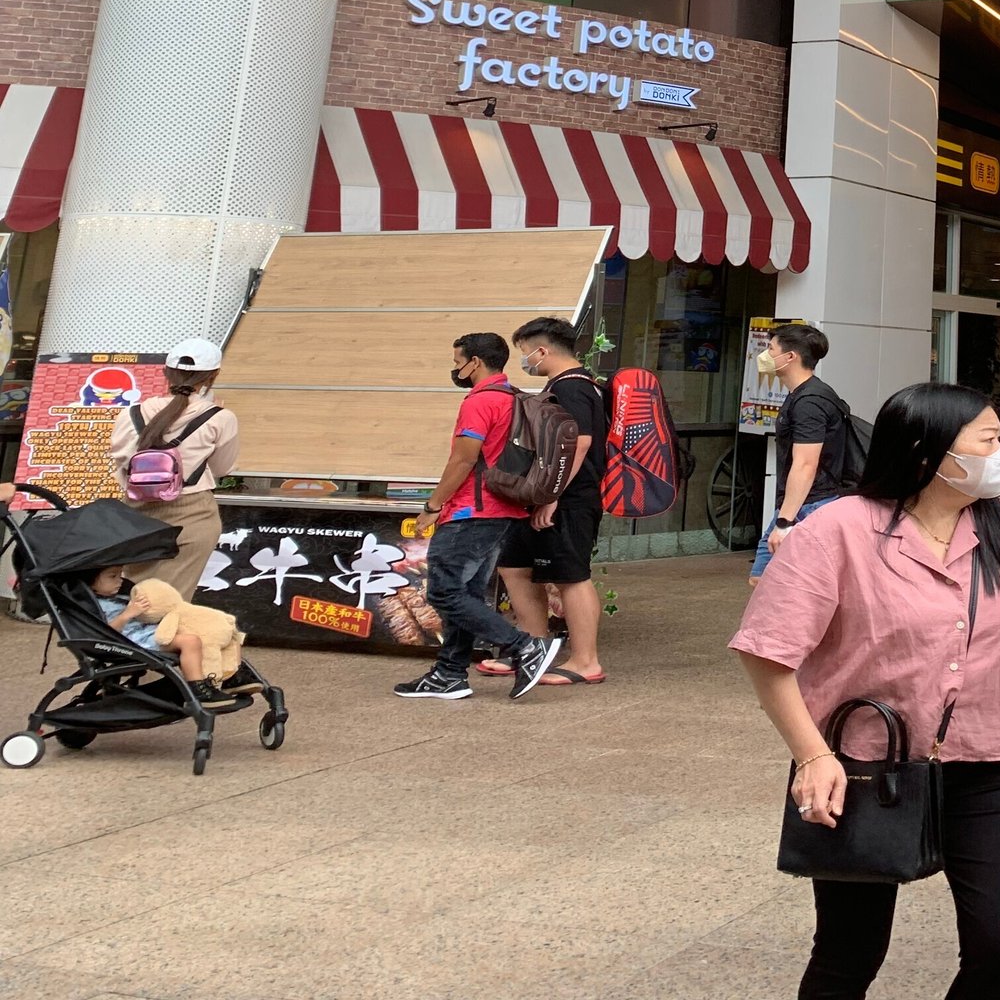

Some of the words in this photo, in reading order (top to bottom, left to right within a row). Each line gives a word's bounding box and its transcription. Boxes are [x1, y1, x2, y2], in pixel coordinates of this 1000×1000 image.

[574, 18, 715, 63] potato
[455, 36, 632, 111] factory
[258, 525, 306, 535] WAGYU
[306, 527, 363, 538] SKEWER
